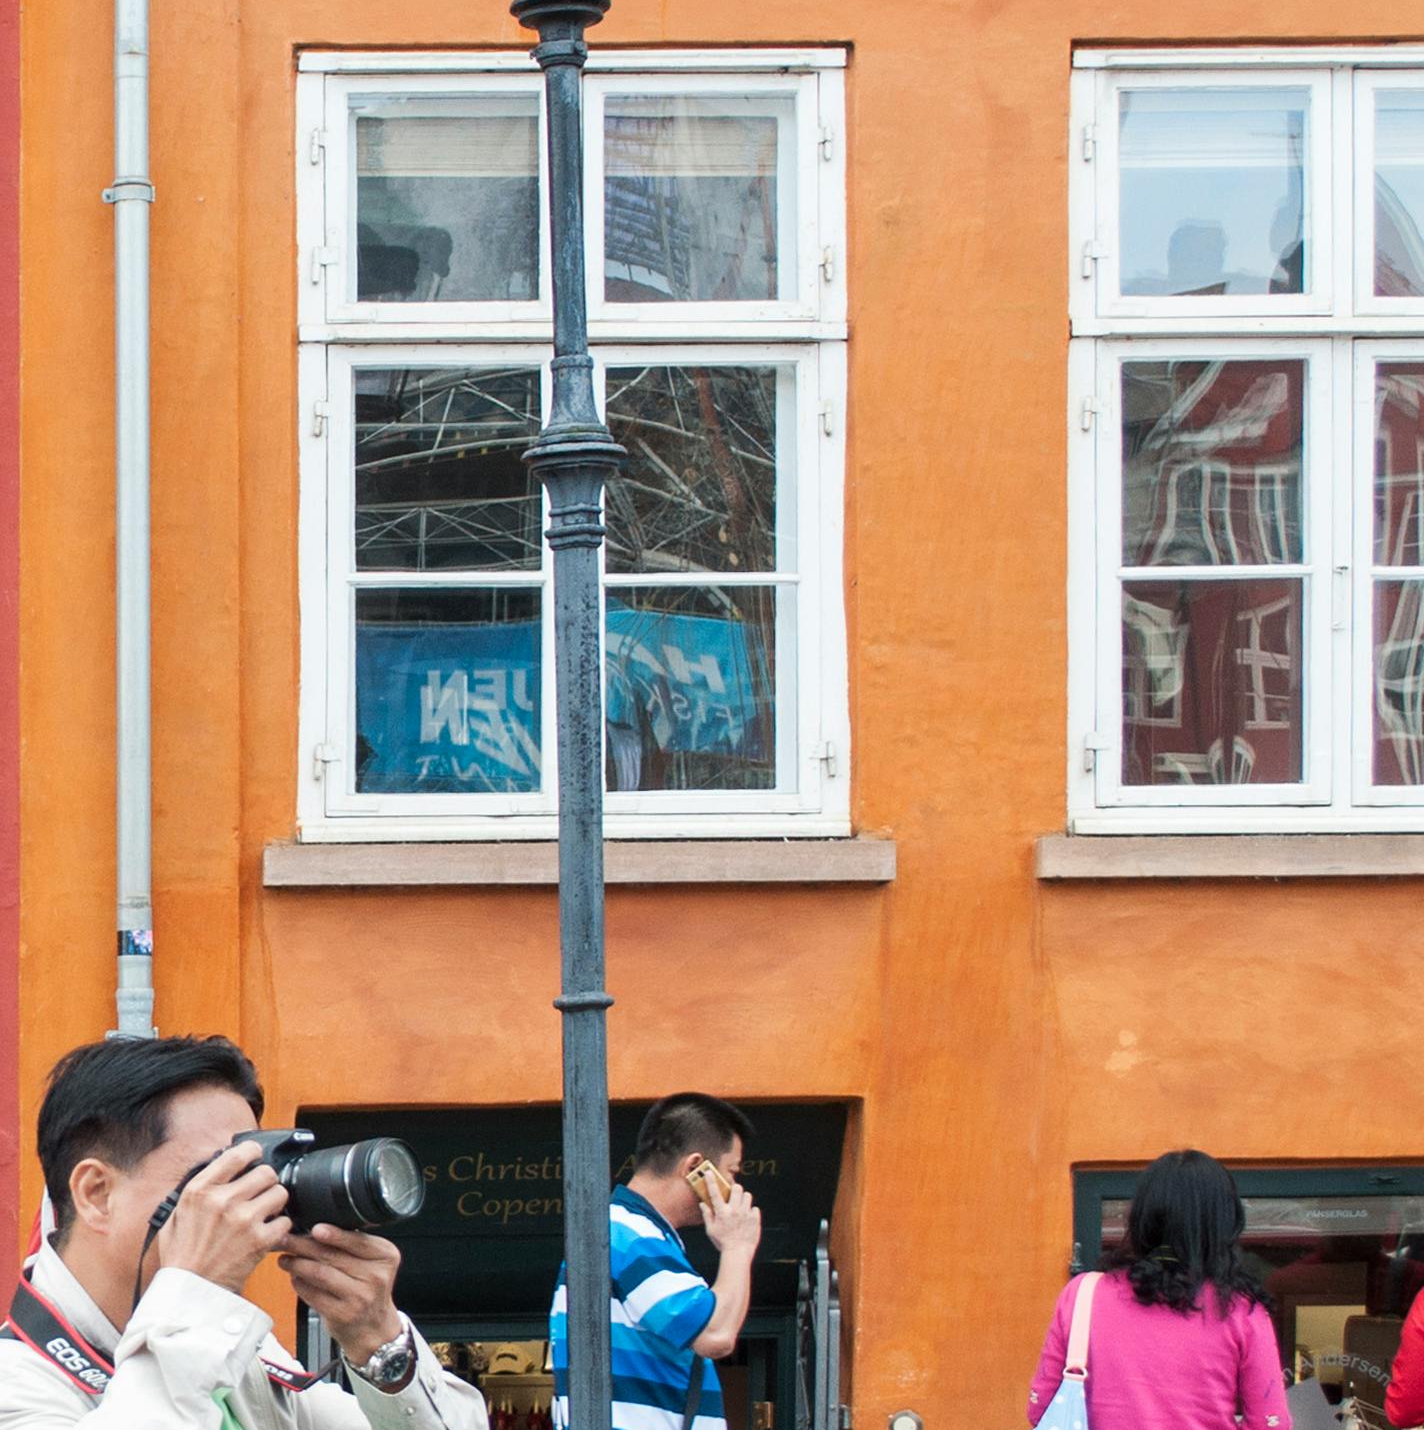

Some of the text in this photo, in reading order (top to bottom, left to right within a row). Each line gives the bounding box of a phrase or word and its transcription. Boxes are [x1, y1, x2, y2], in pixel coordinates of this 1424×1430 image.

[448, 1152, 564, 1181] Christi
[457, 1191, 564, 1224] Copen
[46, 1337, 90, 1371] EOS
